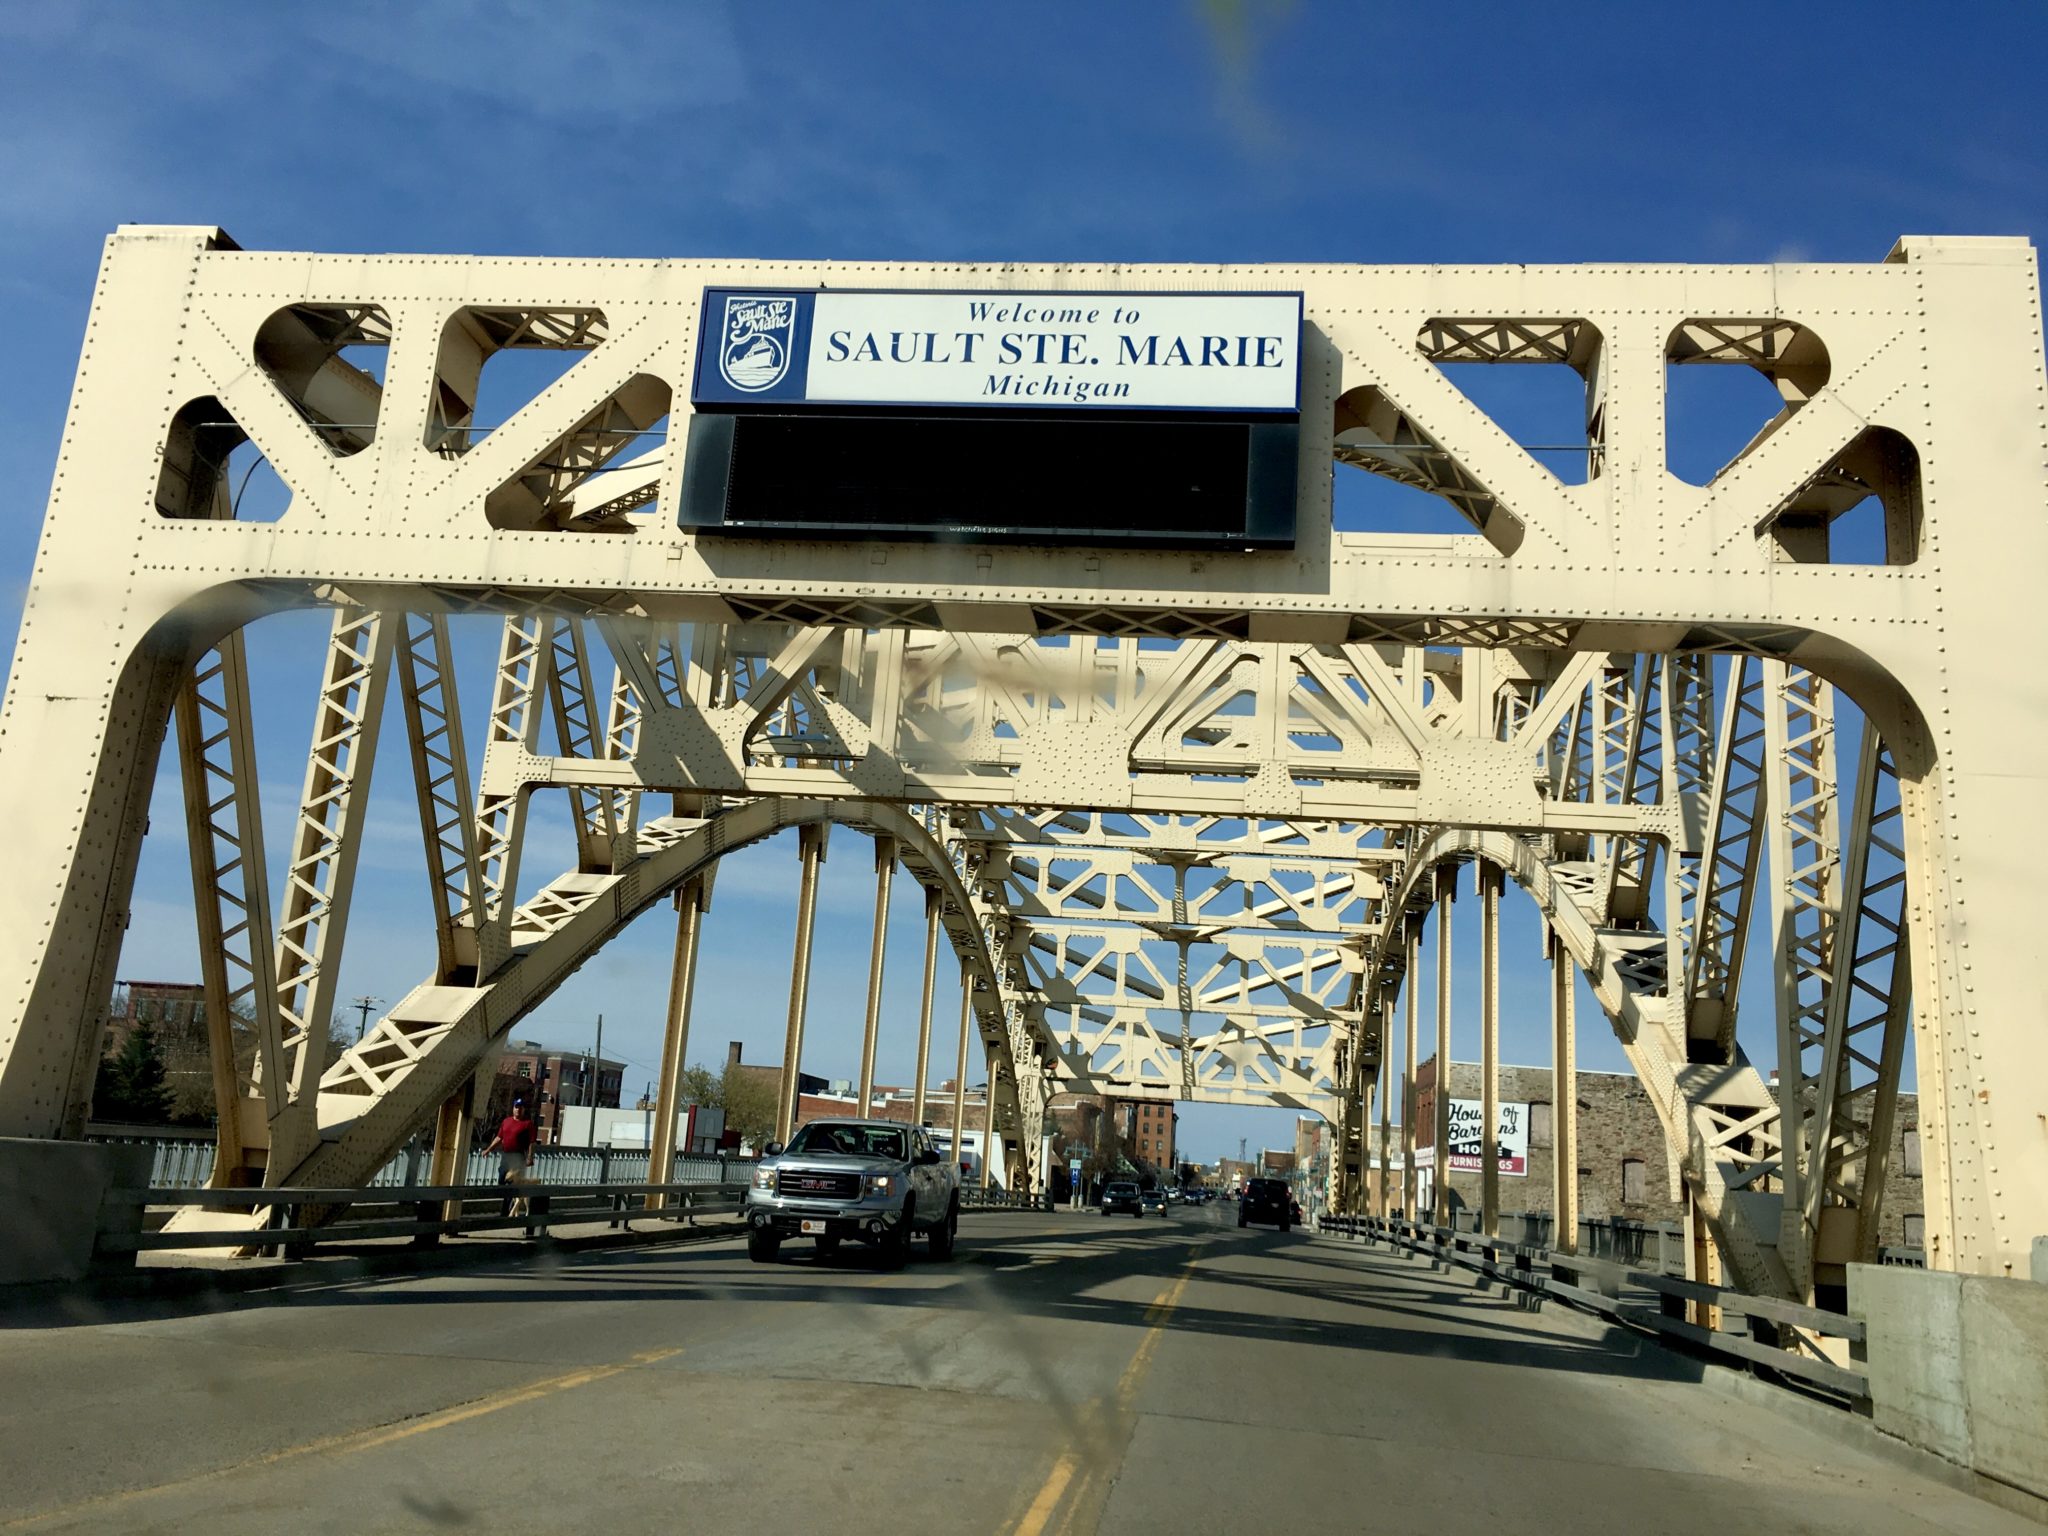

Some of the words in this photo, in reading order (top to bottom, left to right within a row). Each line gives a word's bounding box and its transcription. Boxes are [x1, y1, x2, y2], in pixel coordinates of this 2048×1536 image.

[731, 304, 767, 329] Sault
[766, 301, 788, 320] Ste
[969, 302, 1100, 325] Welcome
[1114, 305, 1141, 324] to
[826, 331, 985, 364] SAULT
[998, 332, 1099, 366] STE.
[1116, 335, 1284, 368] MARIE
[982, 374, 1132, 402] Michigan
[1449, 1103, 1483, 1121] Hou
[1503, 1106, 1520, 1125] of
[1448, 1123, 1518, 1140] Barns
[1458, 1143, 1503, 1157] HOE
[1072, 1168, 1079, 1176] H
[1448, 1156, 1513, 1170] FURNISGS
